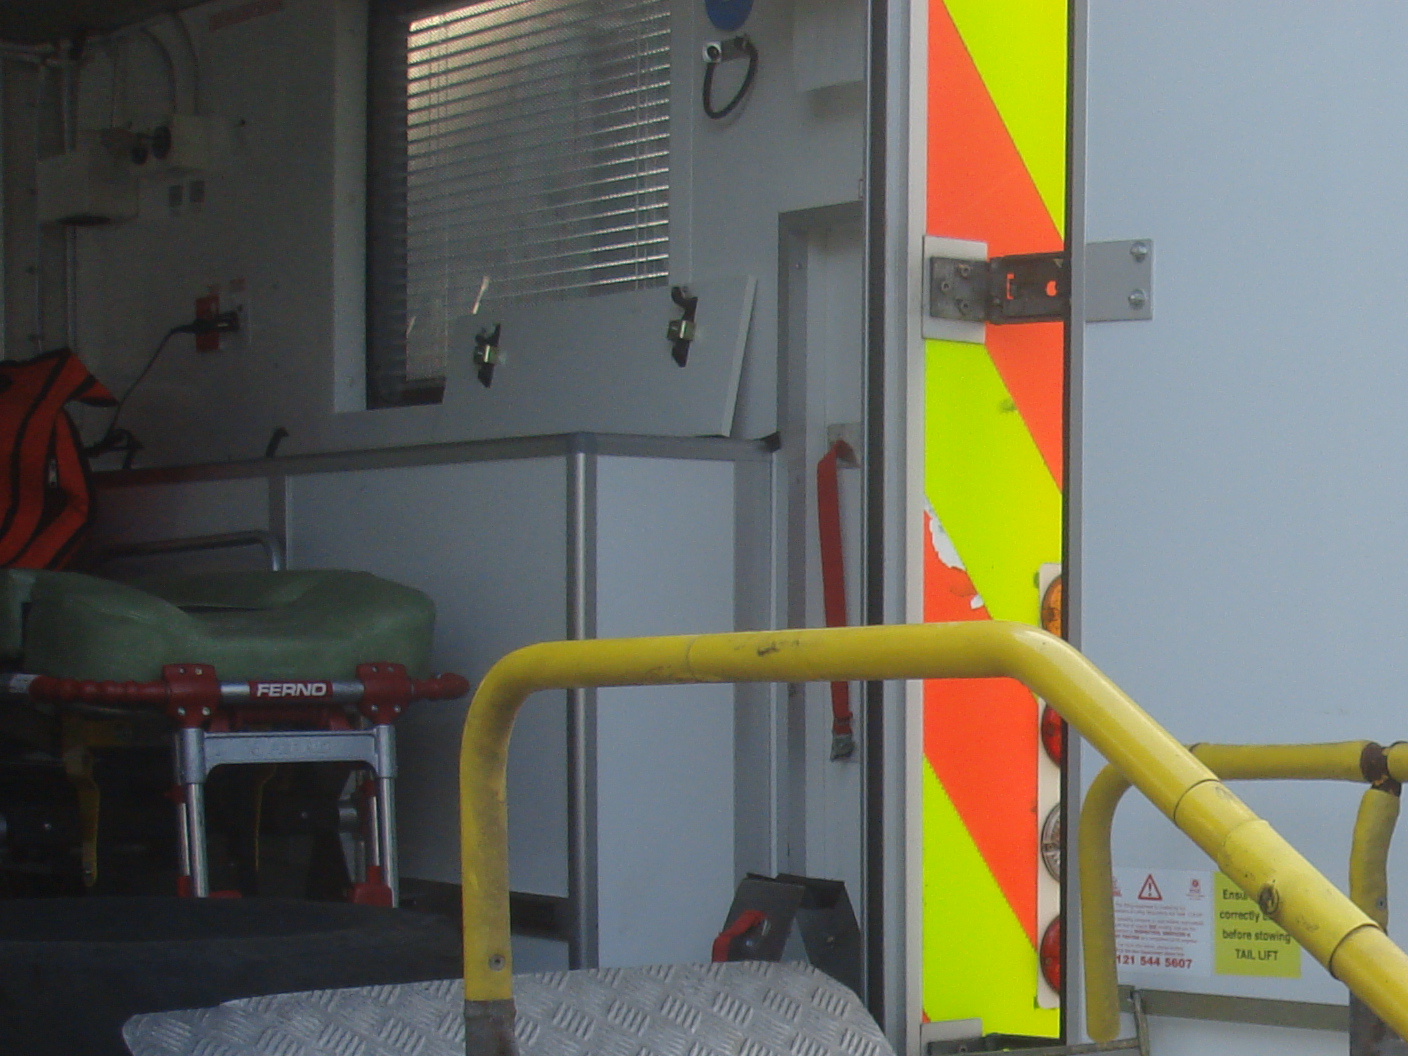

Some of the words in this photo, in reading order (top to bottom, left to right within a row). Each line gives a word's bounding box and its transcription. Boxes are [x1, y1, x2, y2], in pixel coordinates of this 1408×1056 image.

[256, 683, 327, 697] FERNO
[1219, 910, 1260, 923] correctly
[1222, 929, 1252, 940] before
[1254, 931, 1292, 945] stowing
[1234, 948, 1256, 960] TAIL
[1258, 949, 1279, 961] LIFT
[1140, 956, 1161, 966] 544
[1164, 957, 1193, 969] 5607
